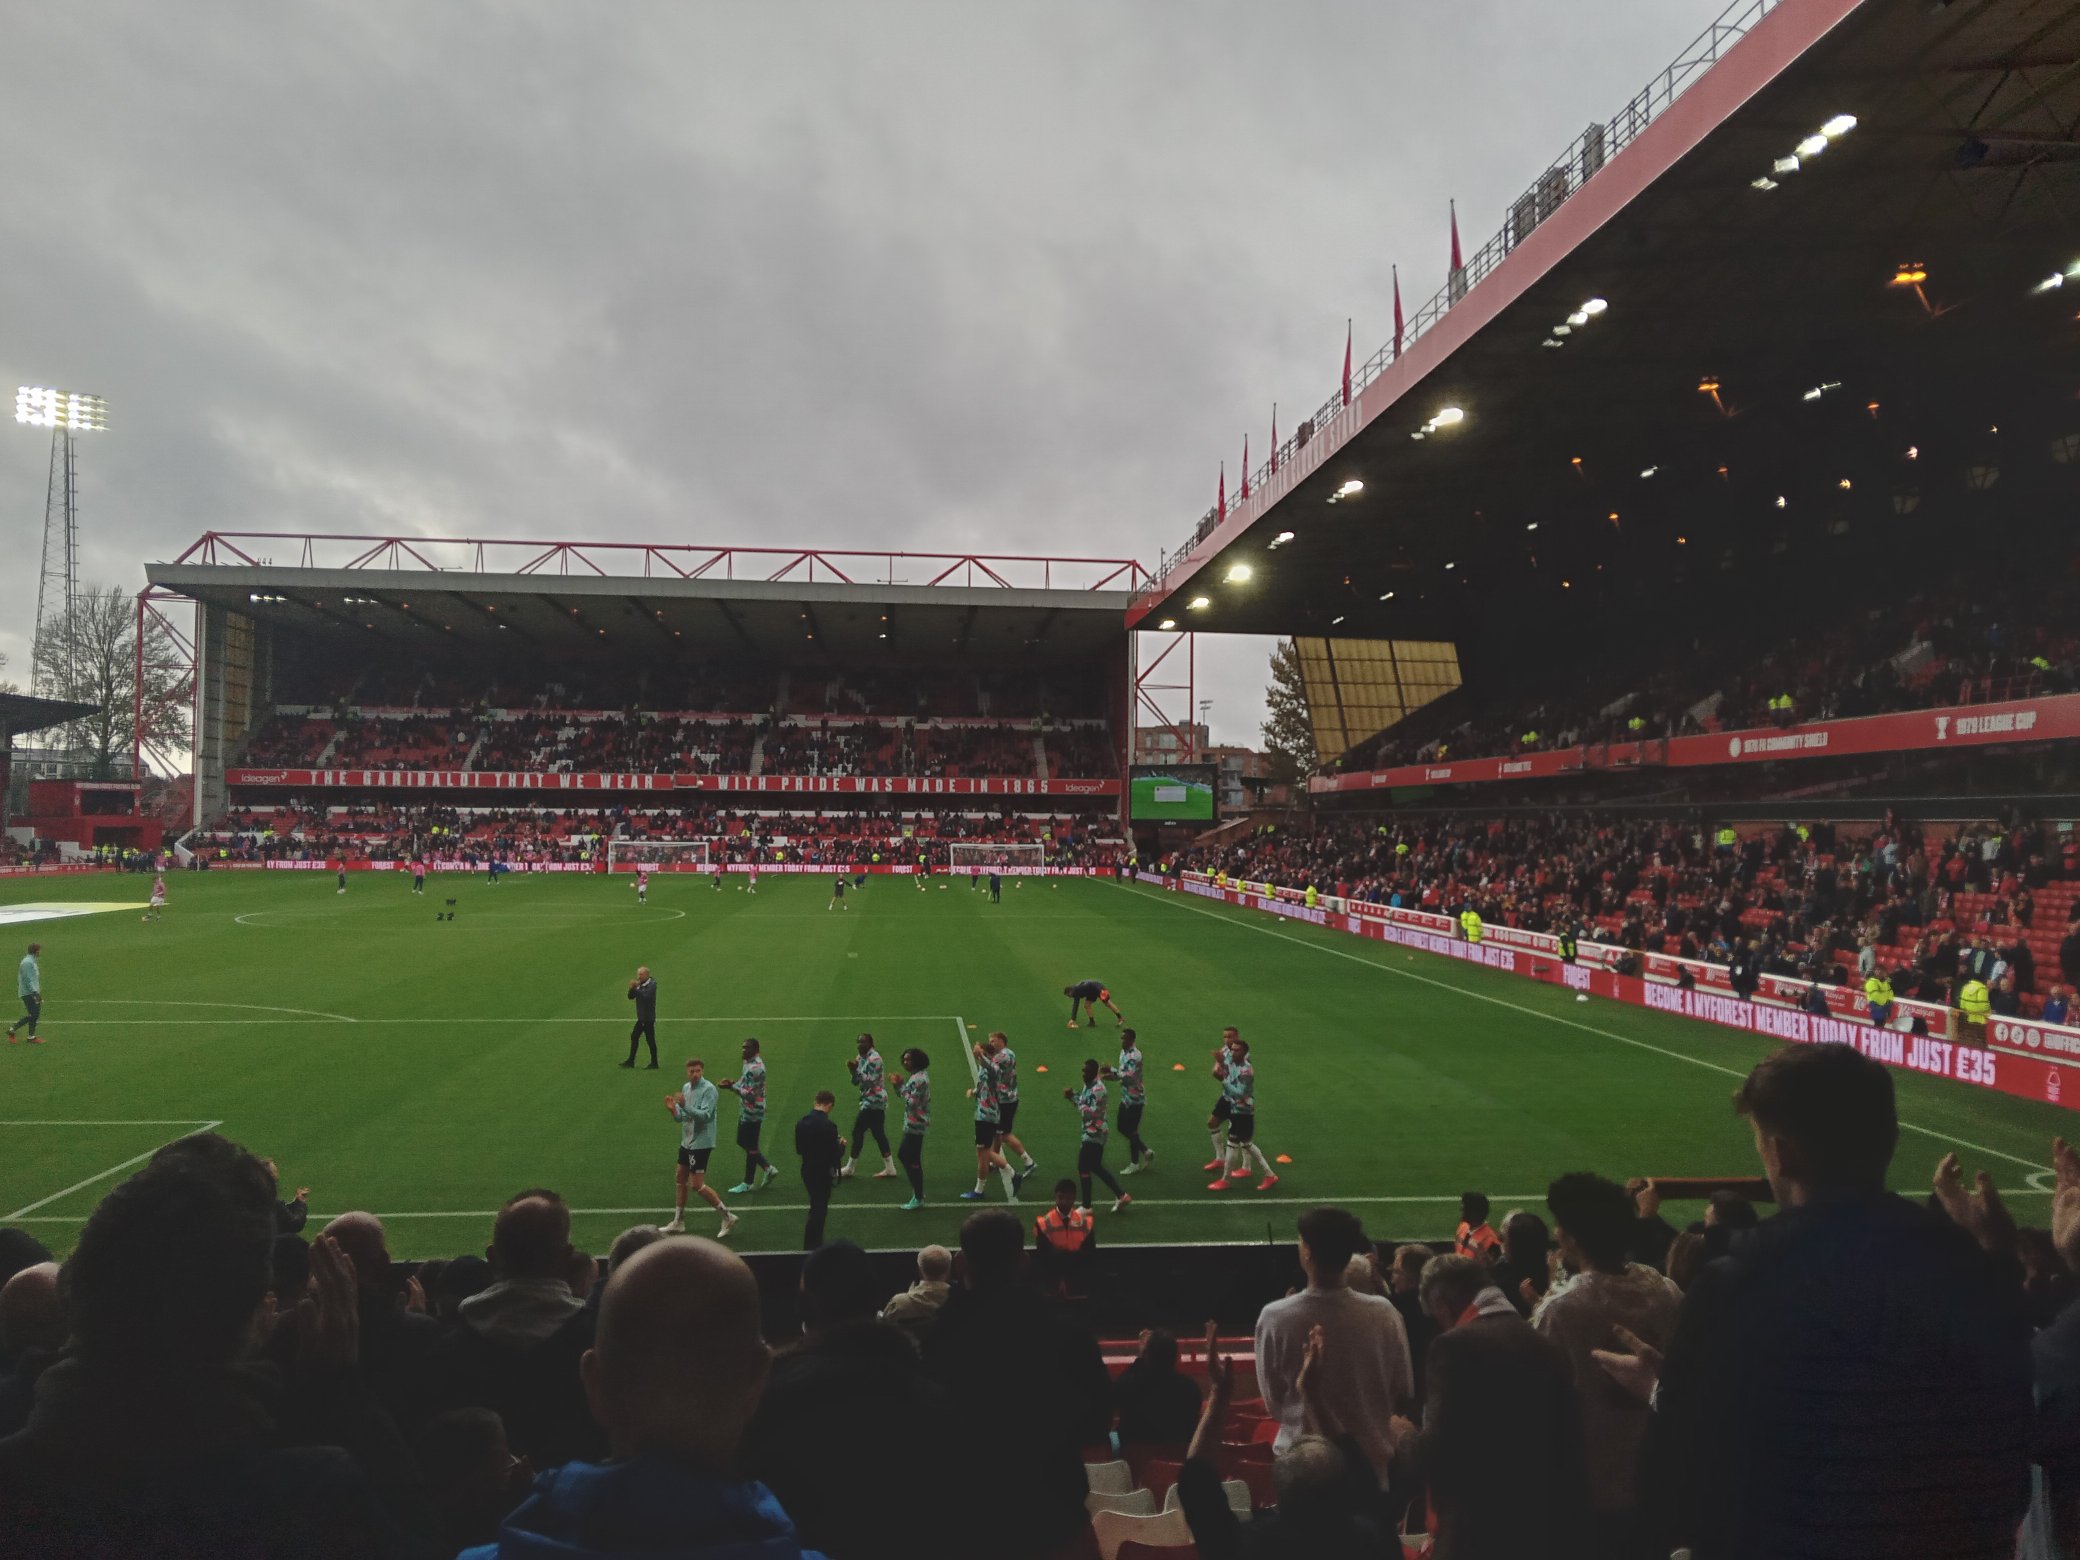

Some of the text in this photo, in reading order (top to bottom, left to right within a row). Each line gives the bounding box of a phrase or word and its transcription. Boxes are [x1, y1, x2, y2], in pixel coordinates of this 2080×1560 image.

[310, 771, 653, 790] THE GARIBALDI THAT WE WEAR
[718, 776, 1049, 794] WITH PRIDE WAS MADE IN 1865
[275, 860, 293, 869] FROM
[293, 860, 311, 869] JUST
[311, 860, 327, 869] £35
[371, 861, 395, 870] FOREST
[562, 862, 579, 871] JUST
[758, 864, 783, 873] MEMBER
[783, 864, 803, 873] TODAY
[803, 864, 820, 873] FROM
[820, 865, 837, 873] JUST
[1644, 982, 1997, 1086] BECOME A MYFOREST MEMBER TODAY FROM JUST £35
